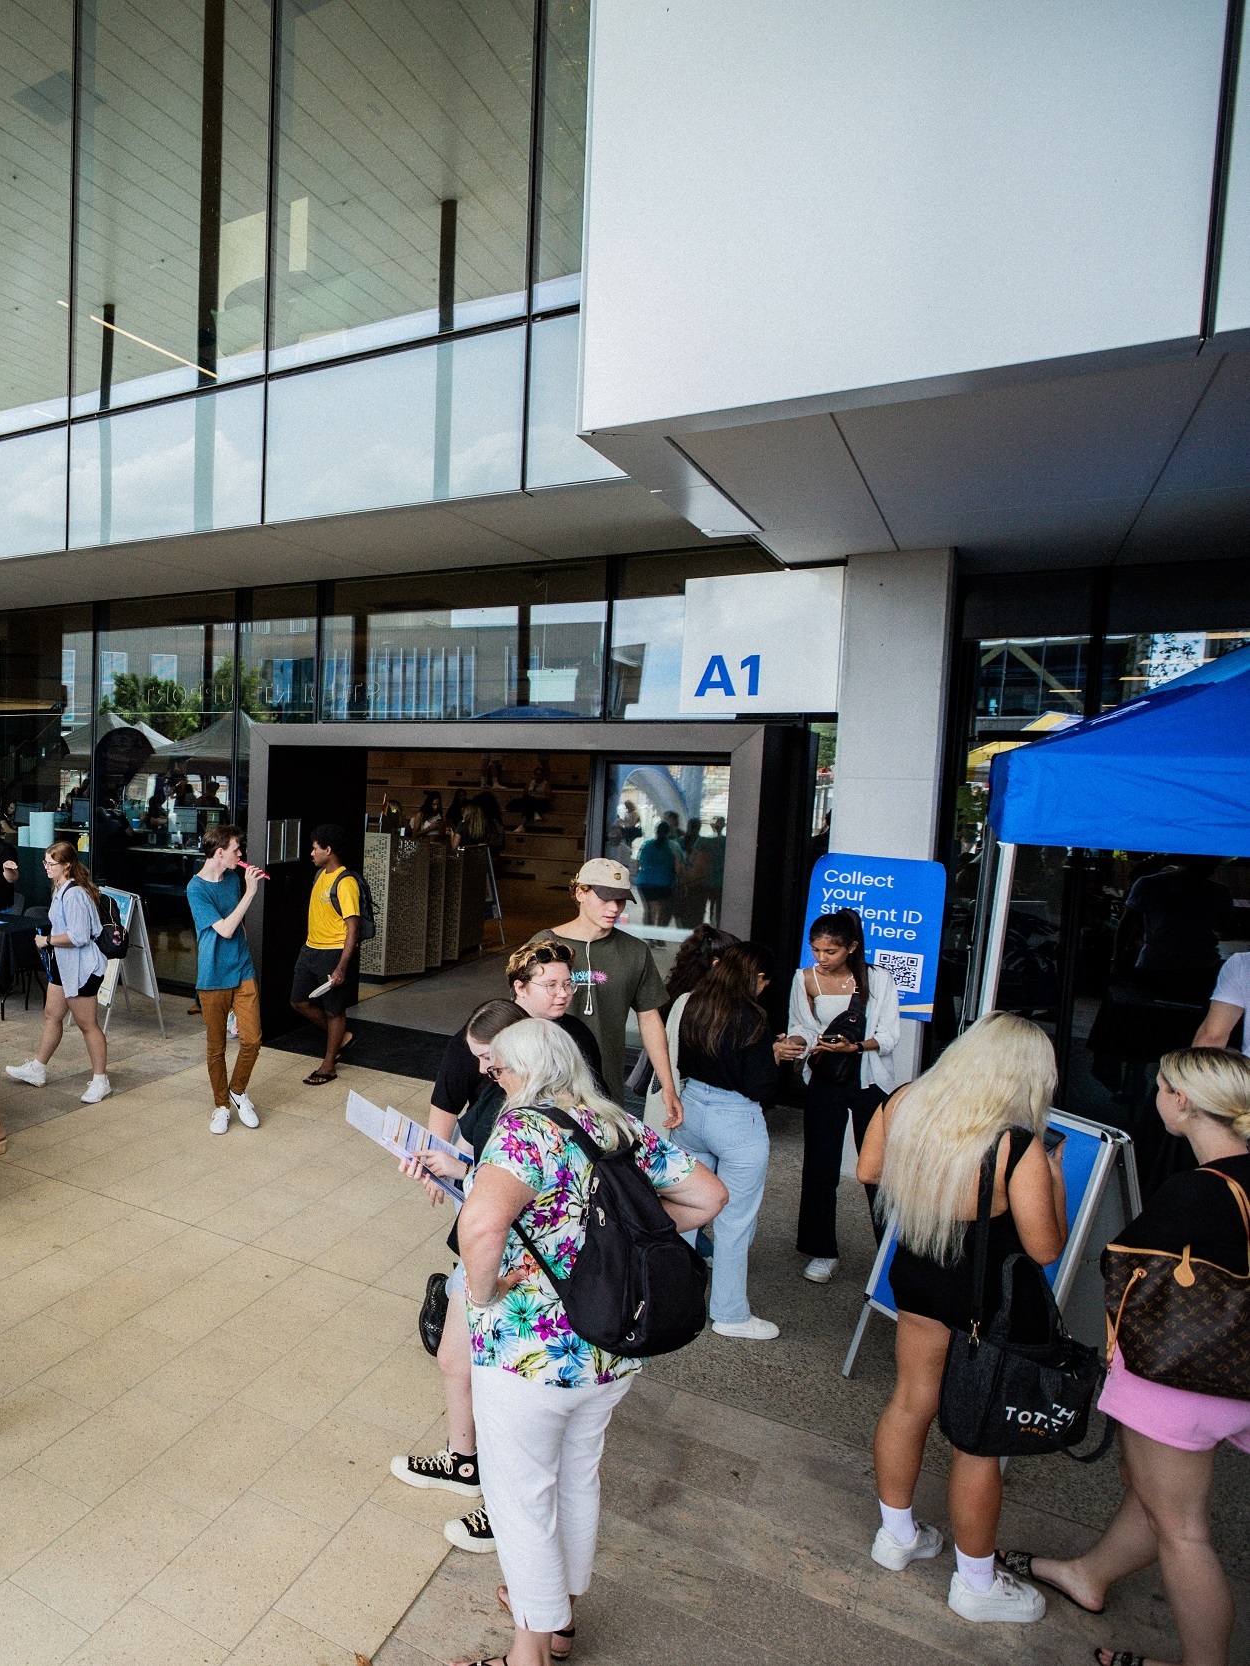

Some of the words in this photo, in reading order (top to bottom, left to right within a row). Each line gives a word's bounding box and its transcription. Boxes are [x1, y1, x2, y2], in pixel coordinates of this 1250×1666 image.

[694, 654, 760, 697] A1
[824, 869, 895, 889] Collect
[822, 887, 867, 902] your
[903, 910, 923, 924] ID
[870, 922, 917, 941] here
